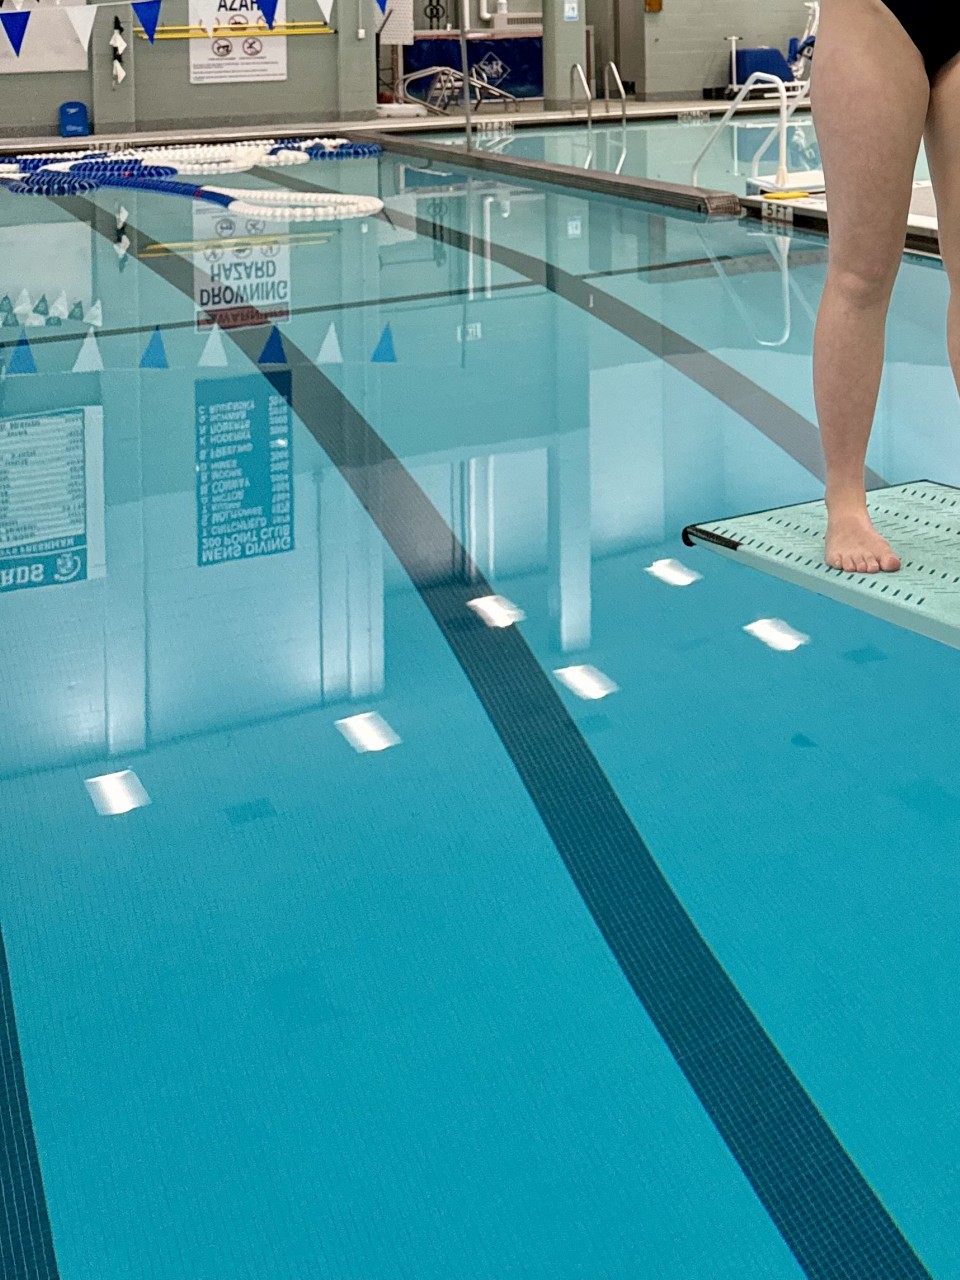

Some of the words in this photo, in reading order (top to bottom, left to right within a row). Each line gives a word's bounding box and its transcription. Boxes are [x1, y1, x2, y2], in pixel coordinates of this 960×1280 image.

[99, 142, 110, 151] FT
[115, 142, 121, 151] 6
[123, 141, 134, 150] IN
[767, 203, 773, 216] 5
[776, 205, 788, 219] FT
